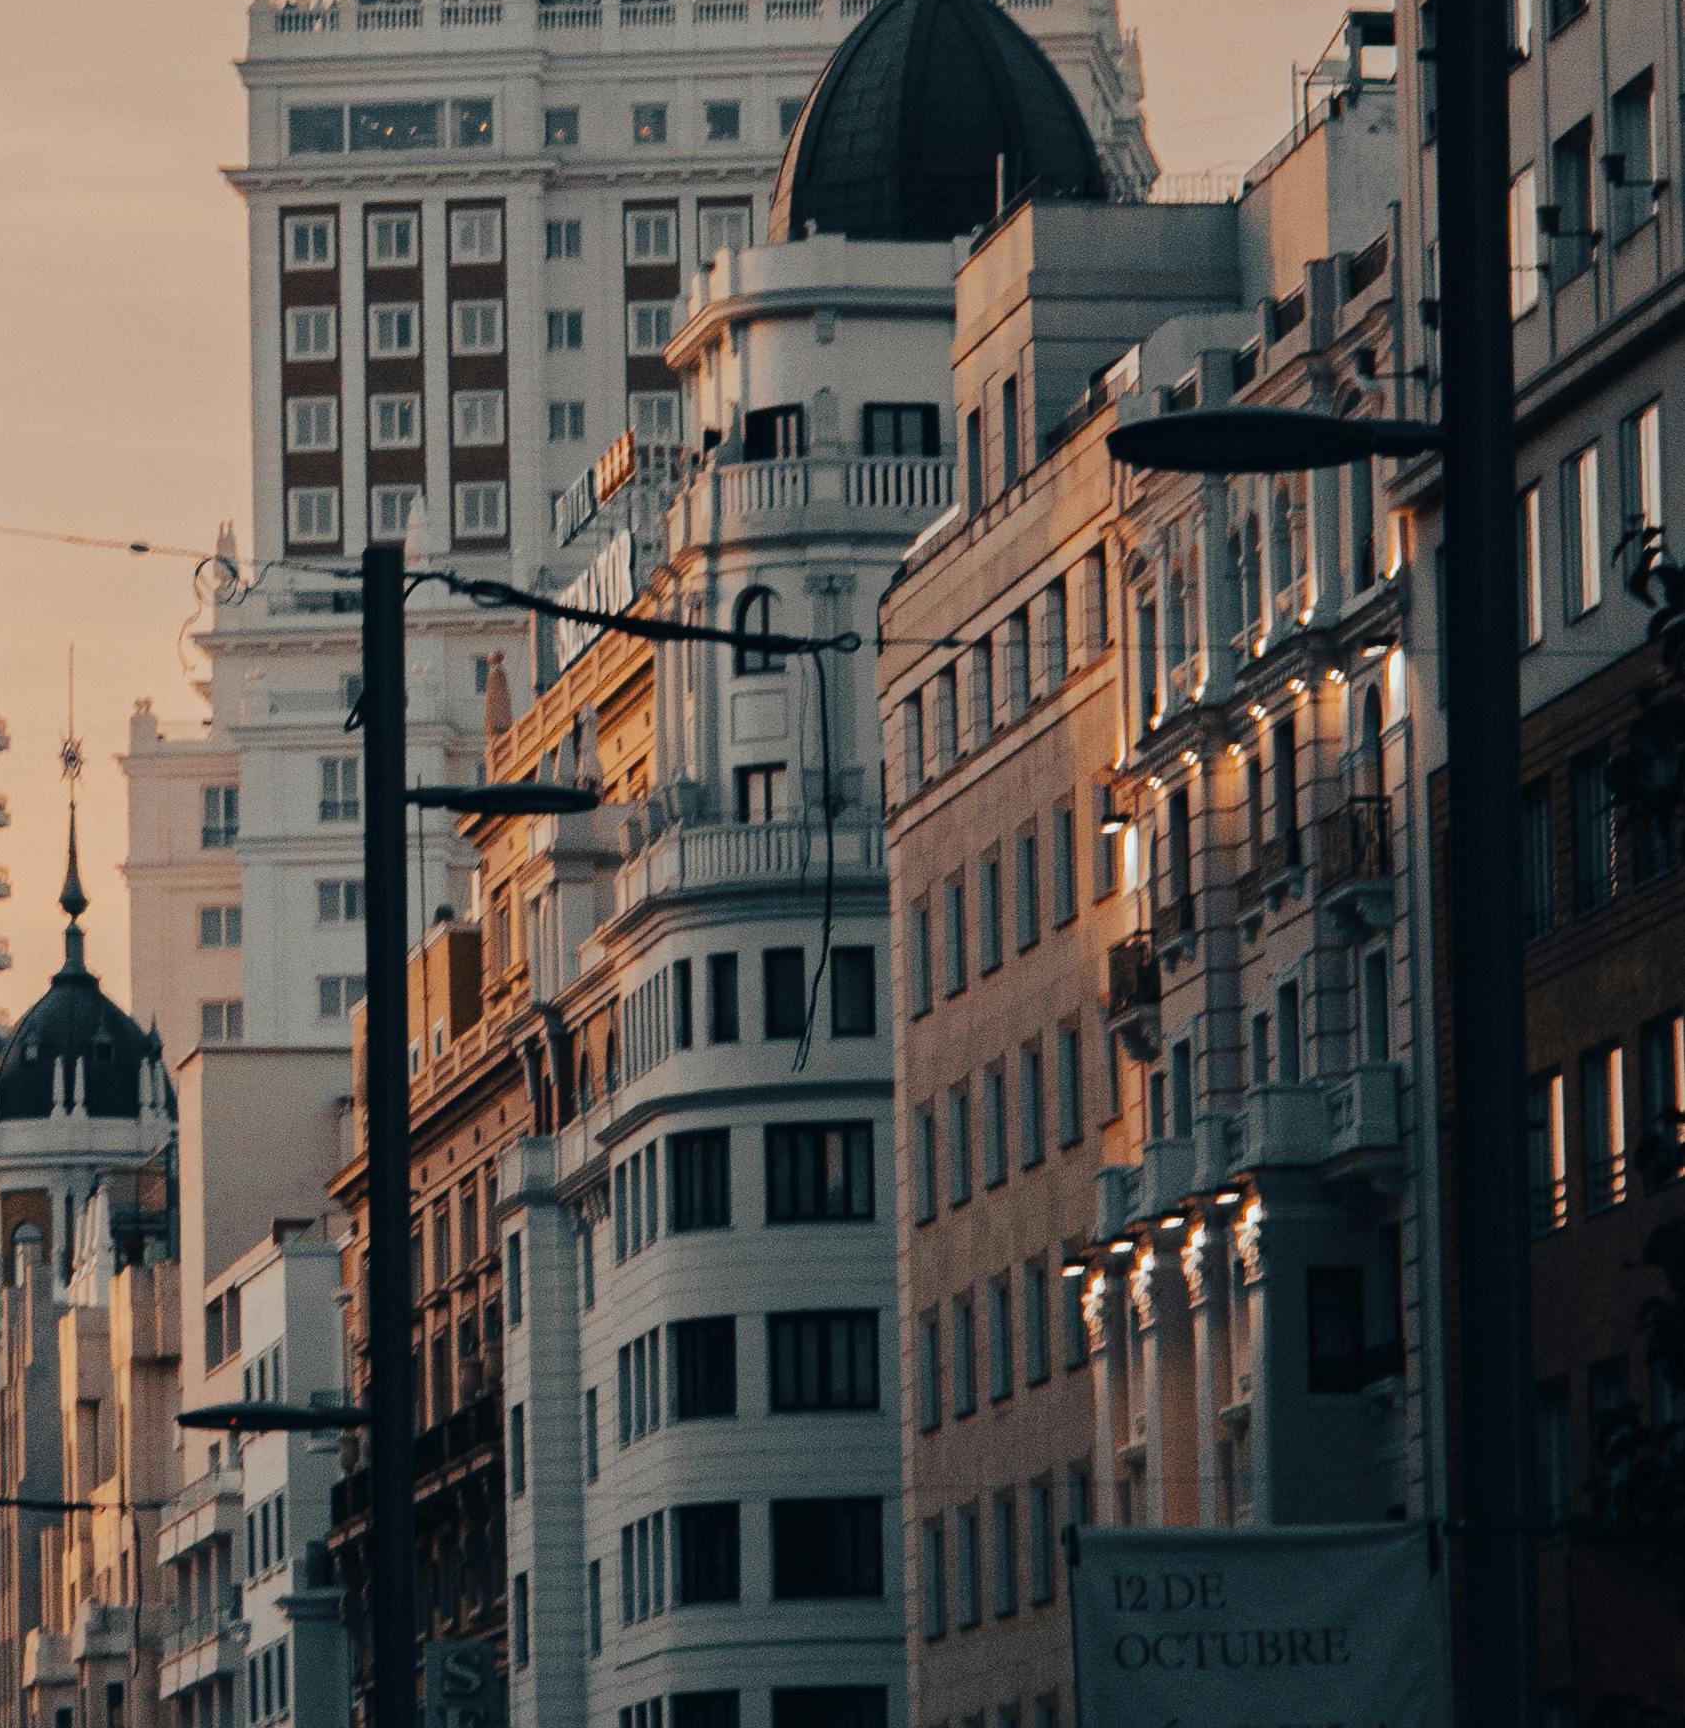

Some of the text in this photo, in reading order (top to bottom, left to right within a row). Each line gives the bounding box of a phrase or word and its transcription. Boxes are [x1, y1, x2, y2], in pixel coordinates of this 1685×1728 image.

[1115, 1573, 1226, 1612] 12 DE
[1115, 1626, 1351, 1671] OCTUBRE
